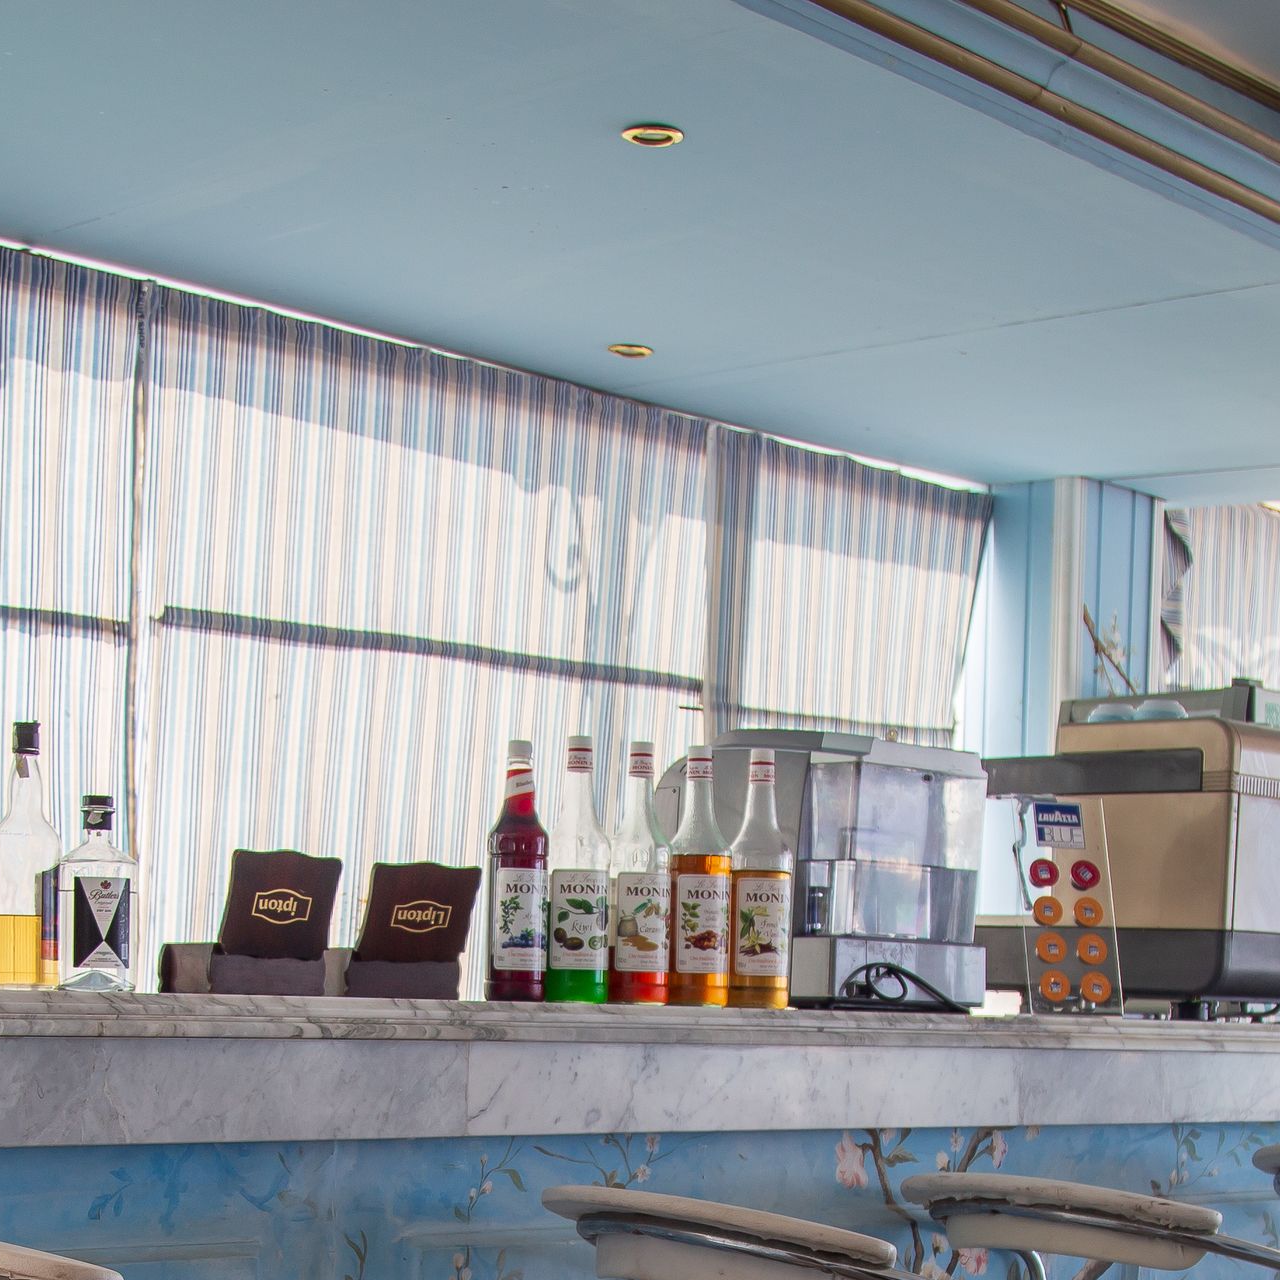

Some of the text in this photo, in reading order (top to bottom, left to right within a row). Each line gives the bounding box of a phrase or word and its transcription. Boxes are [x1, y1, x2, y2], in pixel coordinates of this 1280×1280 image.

[1038, 811, 1079, 824] LAVAZZA
[560, 883, 608, 895] MONIN
[626, 886, 671, 897] MONIN
[397, 906, 445, 925] Lipton
[571, 920, 592, 934] Kiwi
